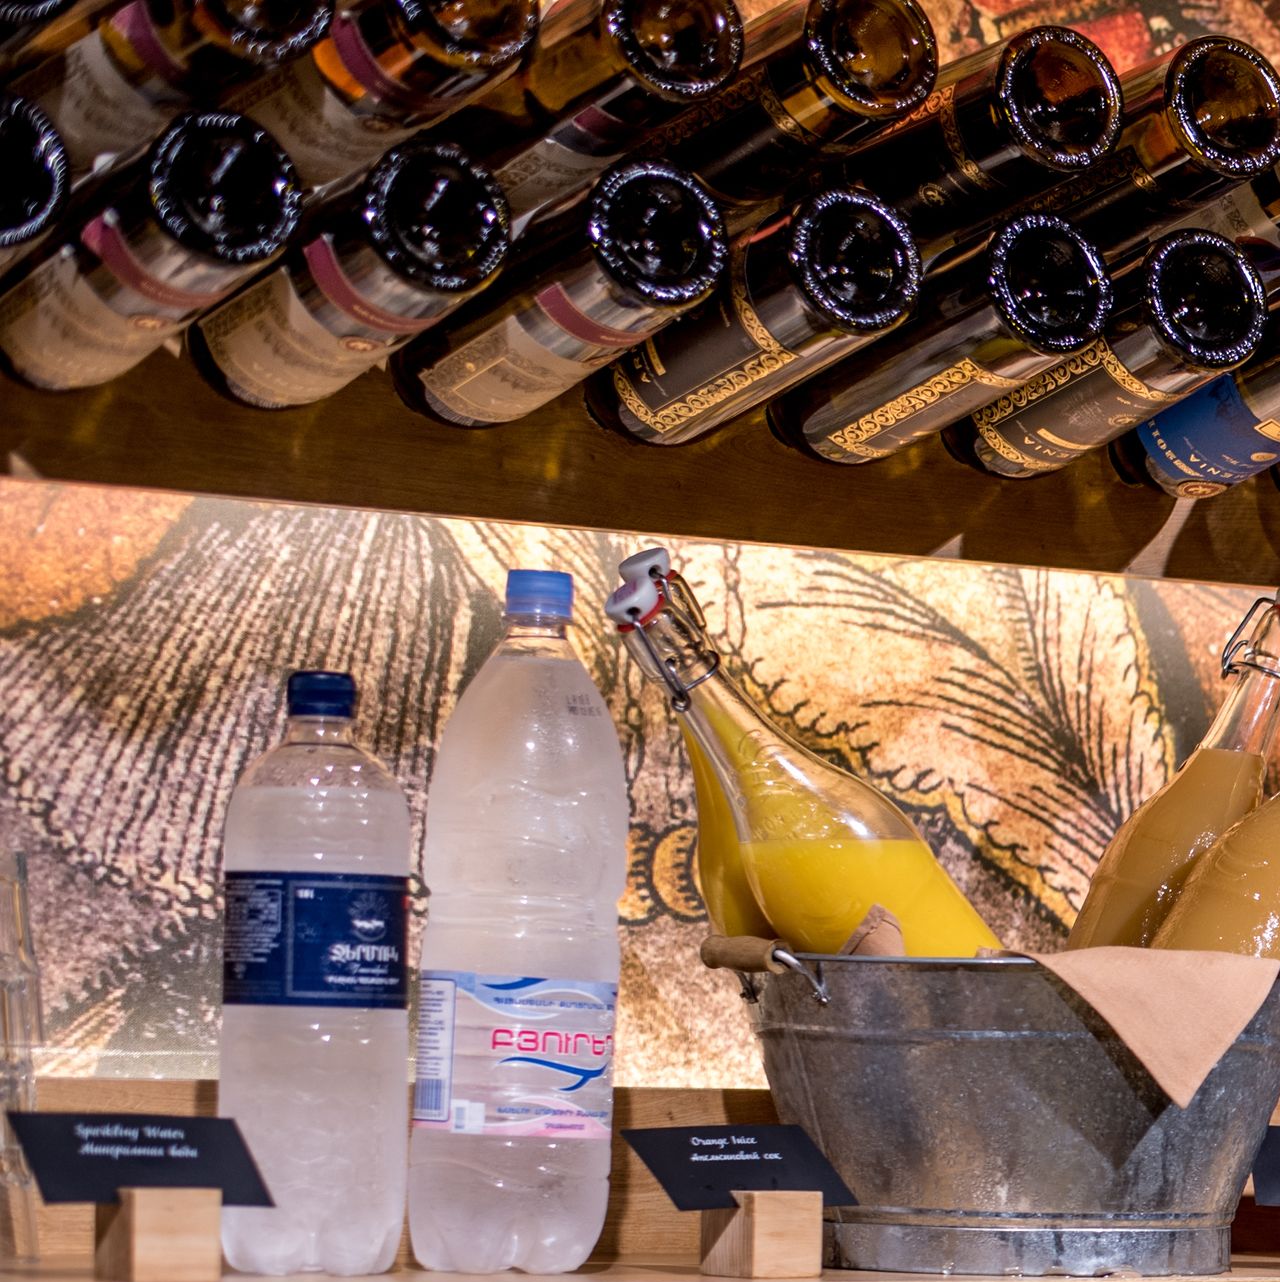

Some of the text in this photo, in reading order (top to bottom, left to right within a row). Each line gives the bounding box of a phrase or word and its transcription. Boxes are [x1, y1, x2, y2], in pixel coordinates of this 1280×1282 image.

[142, 1126, 185, 1139] Water
[690, 1136, 729, 1149] Orange
[763, 1151, 783, 1160] сок
